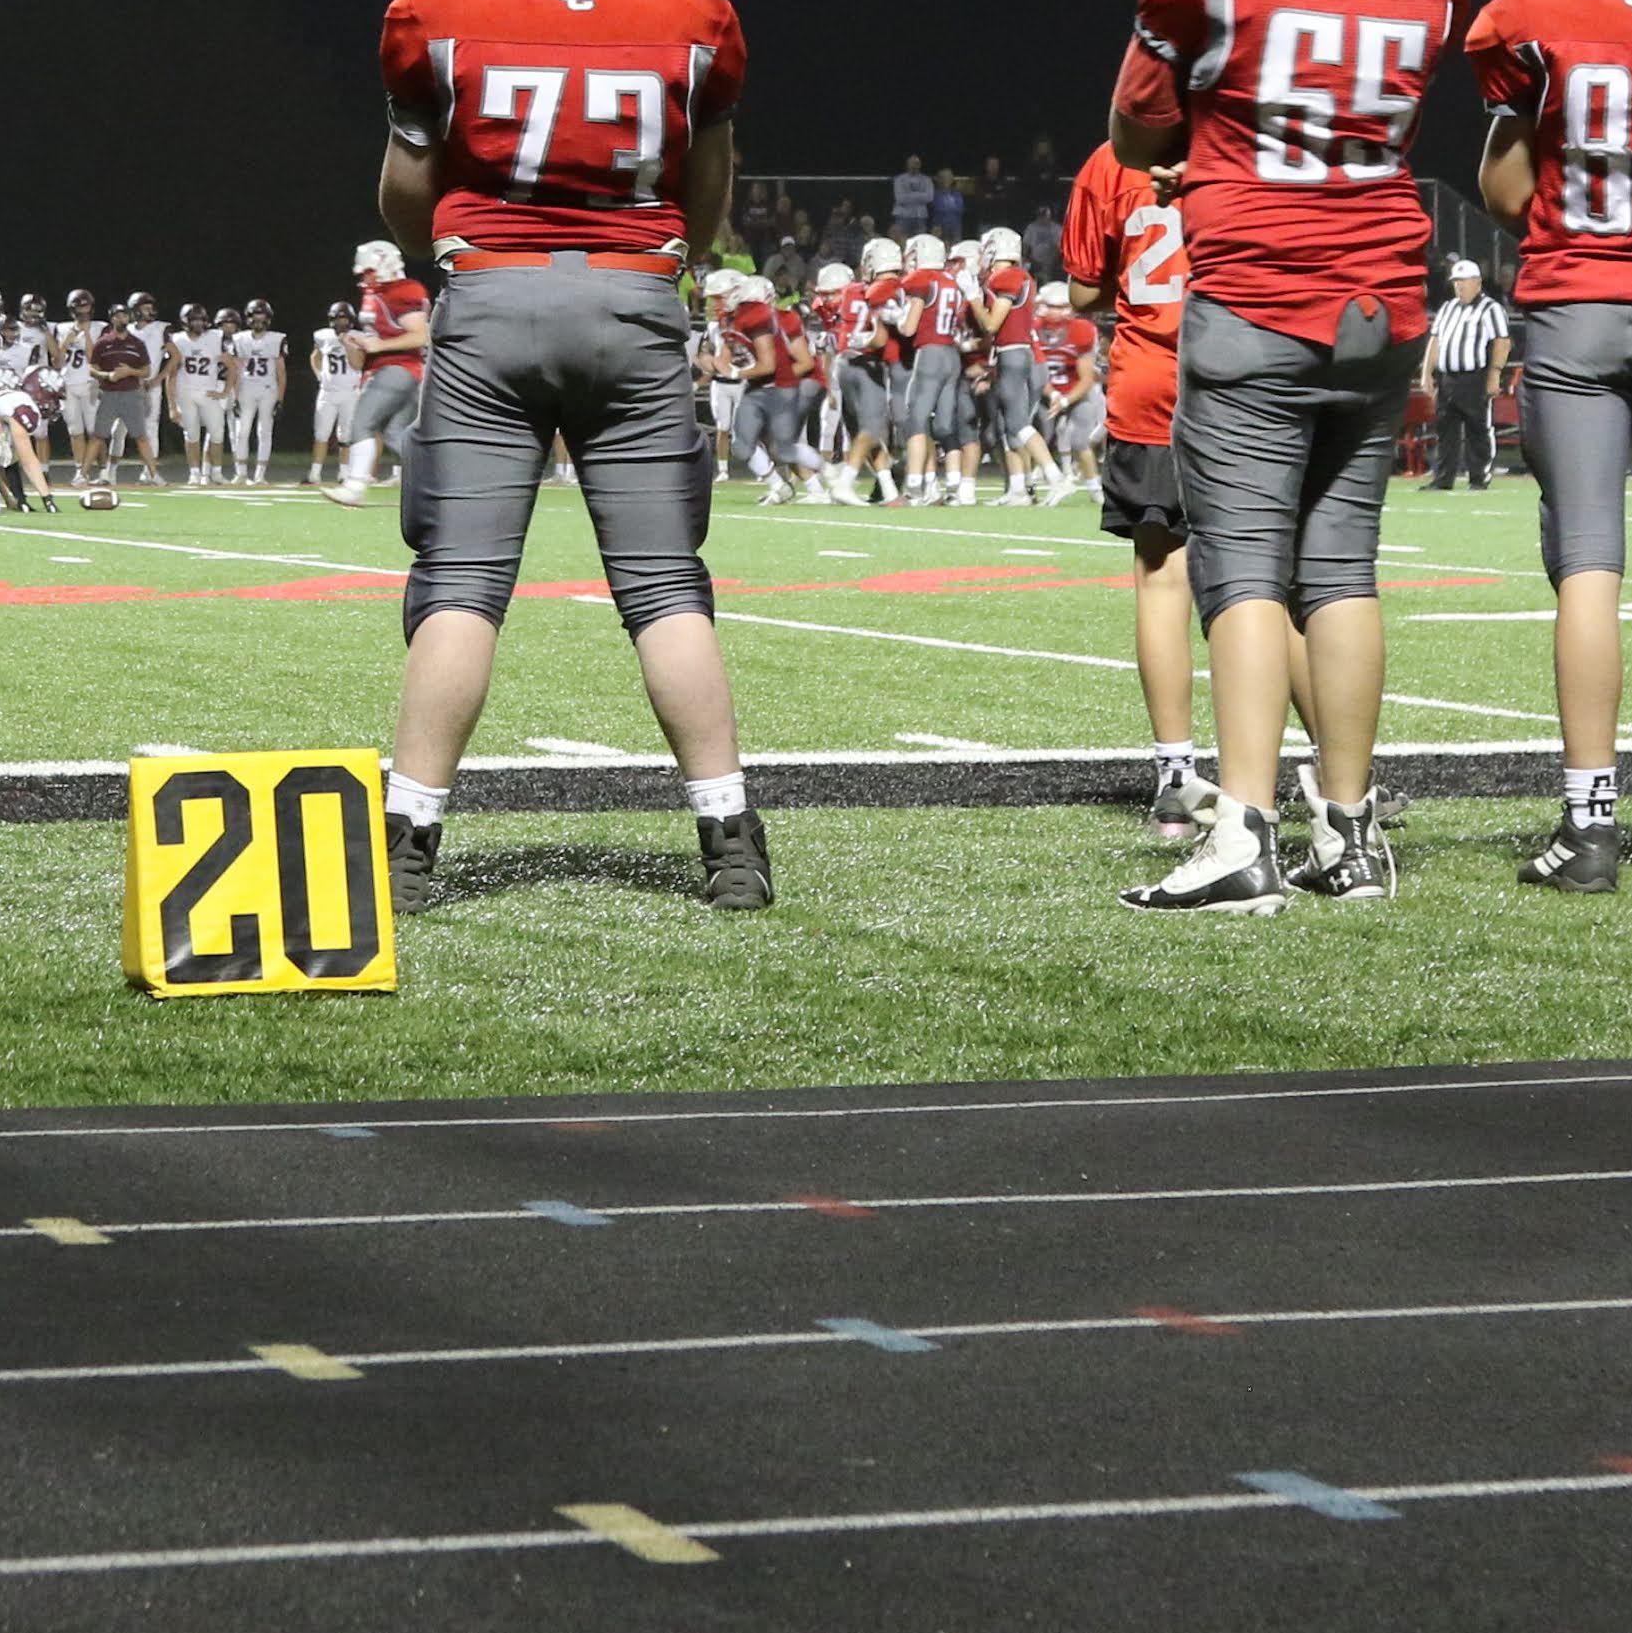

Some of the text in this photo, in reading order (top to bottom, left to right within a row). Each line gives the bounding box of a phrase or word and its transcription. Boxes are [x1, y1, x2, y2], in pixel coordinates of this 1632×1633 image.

[479, 65, 665, 208] 73
[1255, 8, 1428, 183] 65
[246, 357, 269, 377] 43
[328, 353, 348, 375] 61
[153, 765, 379, 985] 20
